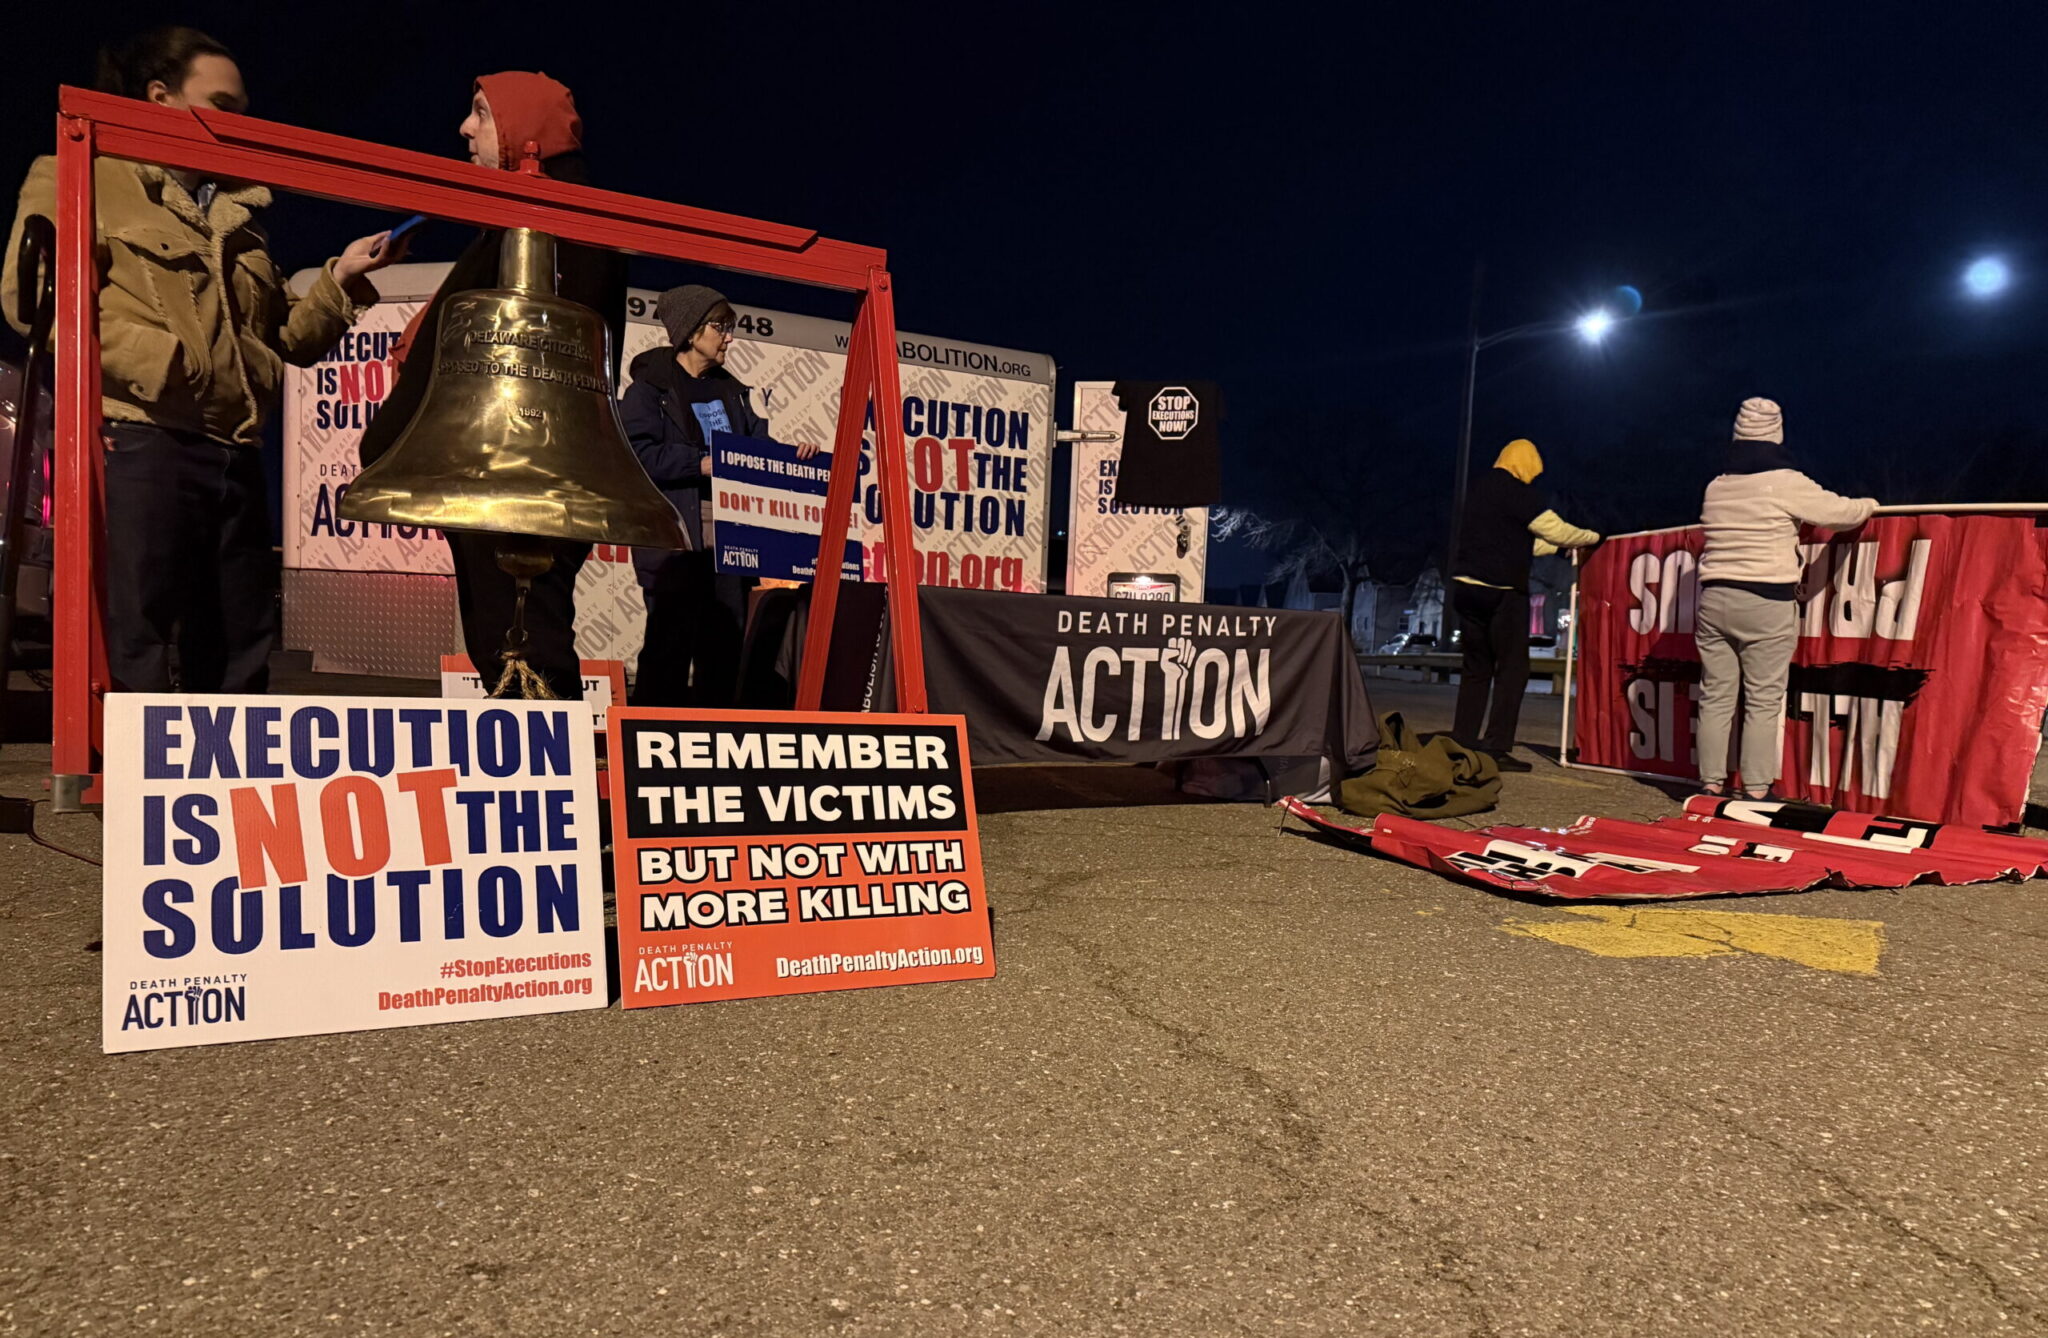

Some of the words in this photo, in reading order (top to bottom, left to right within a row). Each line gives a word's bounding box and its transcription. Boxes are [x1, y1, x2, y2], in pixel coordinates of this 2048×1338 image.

[317, 367, 337, 396] IS
[339, 360, 394, 405] NO
[485, 361, 501, 374] TO
[503, 363, 528, 378] THE
[519, 407, 541, 418] 1992
[1152, 410, 1195, 420] EXECUTIONS
[1157, 395, 1191, 411] STOP
[1159, 420, 1187, 432] NOW!
[320, 463, 364, 477] DEAT
[720, 450, 725, 464] I
[727, 451, 766, 471] OPPOSE
[767, 459, 785, 475] THE
[786, 463, 815, 480] DEATH
[973, 452, 1027, 492] THE
[1098, 479, 1113, 495] IS
[719, 491, 764, 515] DON'T
[769, 498, 800, 520] KILL
[722, 550, 759, 569] ACTION
[1057, 610, 1147, 635] DEATH
[1161, 613, 1279, 637] PENALTY
[1035, 637, 1272, 743] ACTION
[144, 706, 572, 780] EXECUTION
[636, 731, 949, 769] REMEMBER
[637, 786, 745, 824] THE
[758, 784, 957, 822] VICTIMS
[143, 793, 221, 866] IS
[229, 768, 458, 890] NOT
[456, 789, 578, 855] THE
[637, 845, 738, 885] BUT
[747, 842, 848, 880] NOT
[854, 839, 966, 876] WITH
[142, 863, 580, 960] SOLUTION
[640, 887, 789, 931] MORE
[796, 880, 971, 922] KILLING
[638, 945, 678, 955] DEATH
[682, 941, 733, 952] PENALTY
[440, 951, 592, 979] #StopExecutions
[634, 951, 734, 993] ACTION
[776, 945, 985, 978] DeathPenaltyAction.org
[129, 978, 178, 990] DEATH
[184, 973, 249, 987] PENALTY
[121, 985, 246, 1031] ACTION
[378, 977, 594, 1012] DeathPenaltyAction.org
